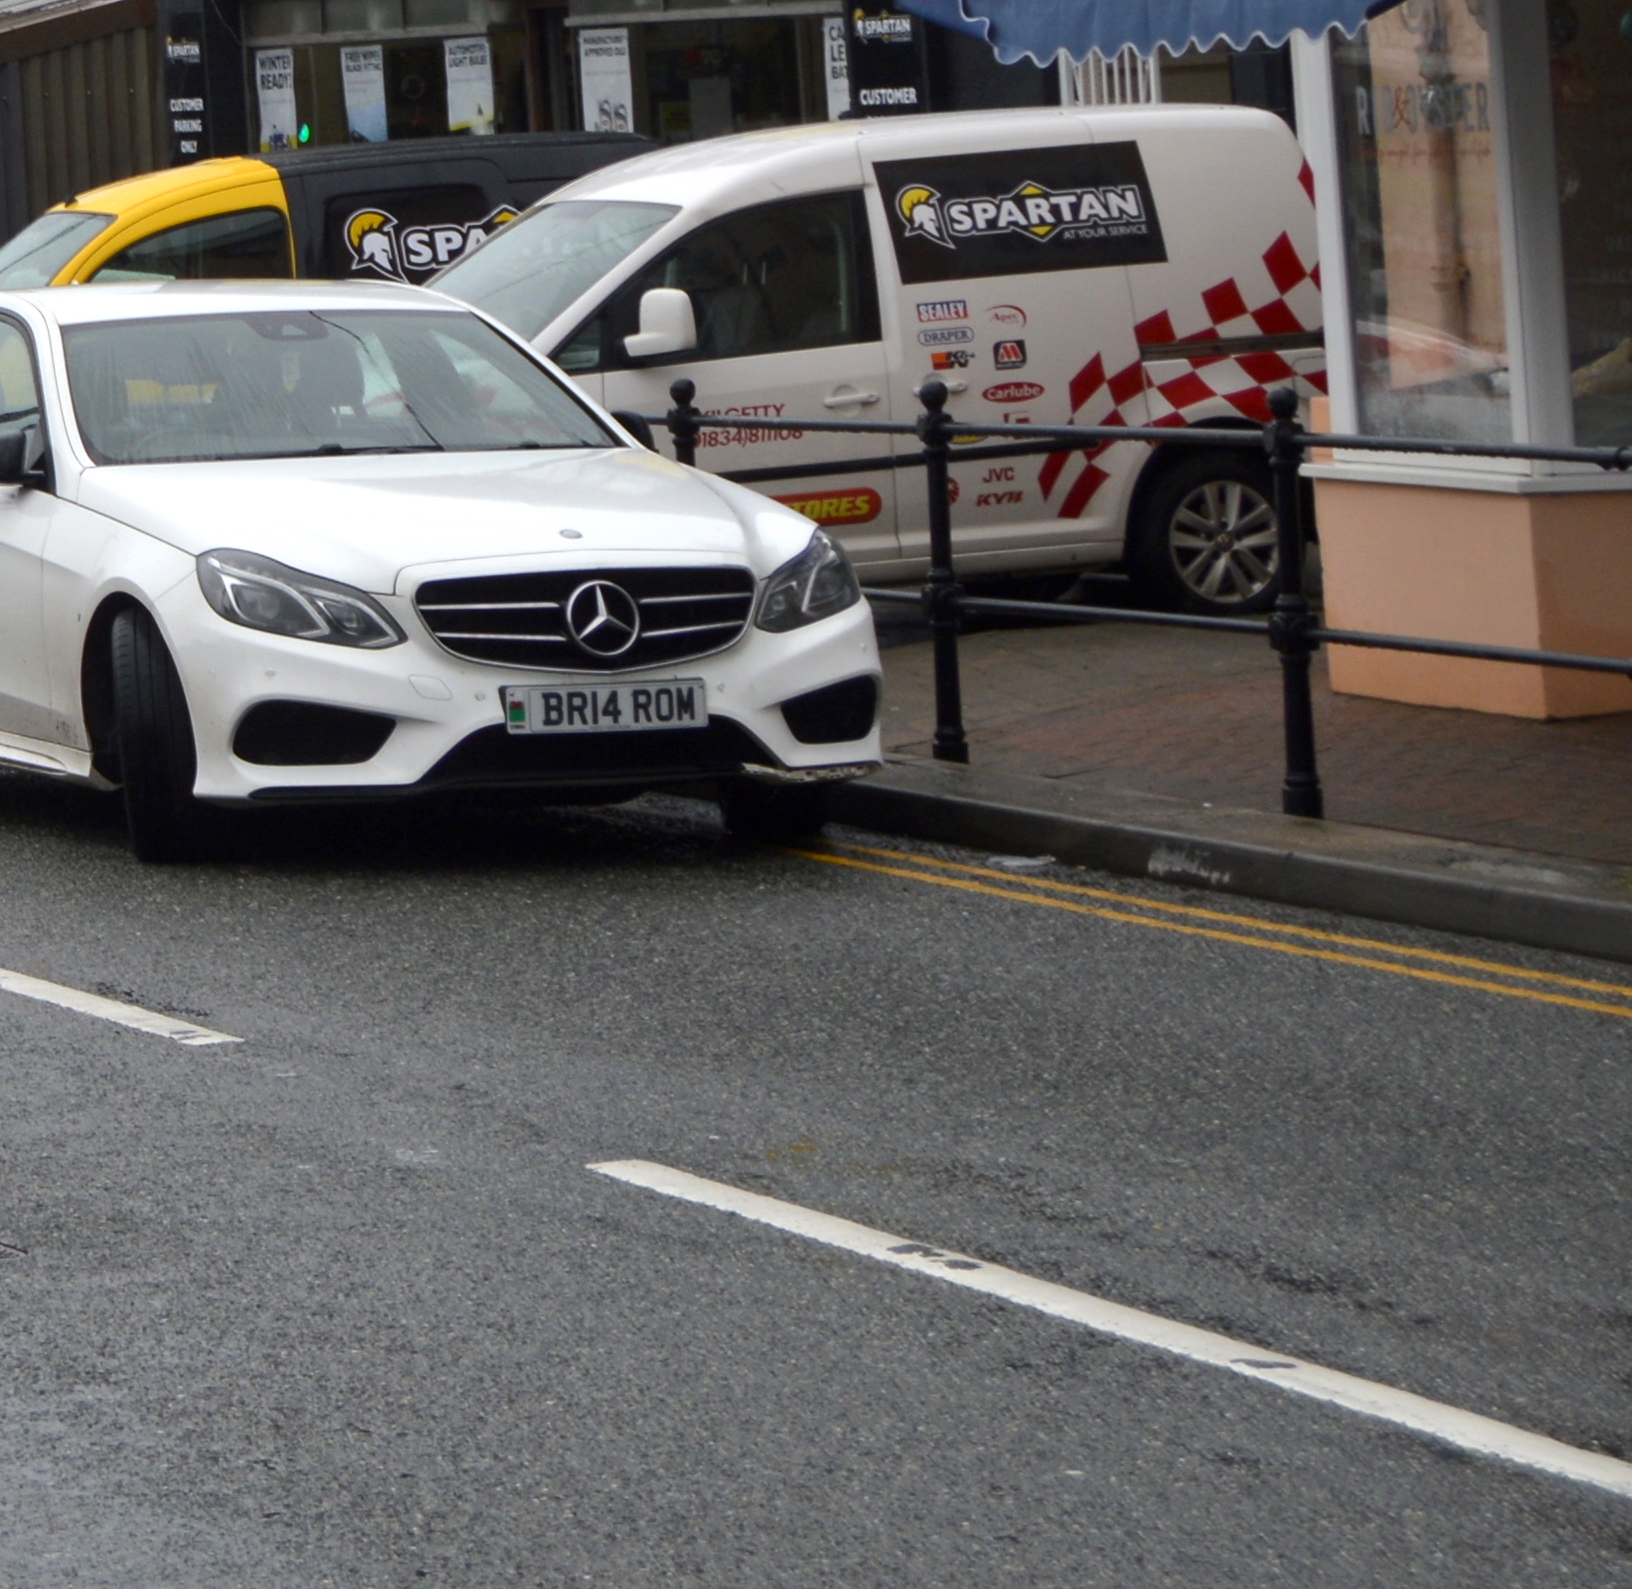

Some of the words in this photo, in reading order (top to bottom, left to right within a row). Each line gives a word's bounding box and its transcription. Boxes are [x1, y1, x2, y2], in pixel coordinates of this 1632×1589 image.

[865, 18, 911, 35] SPARTAN
[859, 87, 918, 106] CUSTOMER
[946, 189, 1141, 232] SPARTAN
[1063, 229, 1078, 240] AT
[1078, 227, 1108, 239] YOUR
[1108, 224, 1149, 238] SERVICE
[406, 227, 491, 265] SPA
[919, 301, 965, 321] SEALEY
[923, 330, 970, 343] DRAPER
[987, 384, 1041, 401] Carlube
[983, 467, 1016, 484] JVC
[785, 495, 870, 520] TORES
[541, 690, 623, 727] BR14
[631, 687, 696, 723] ROM
